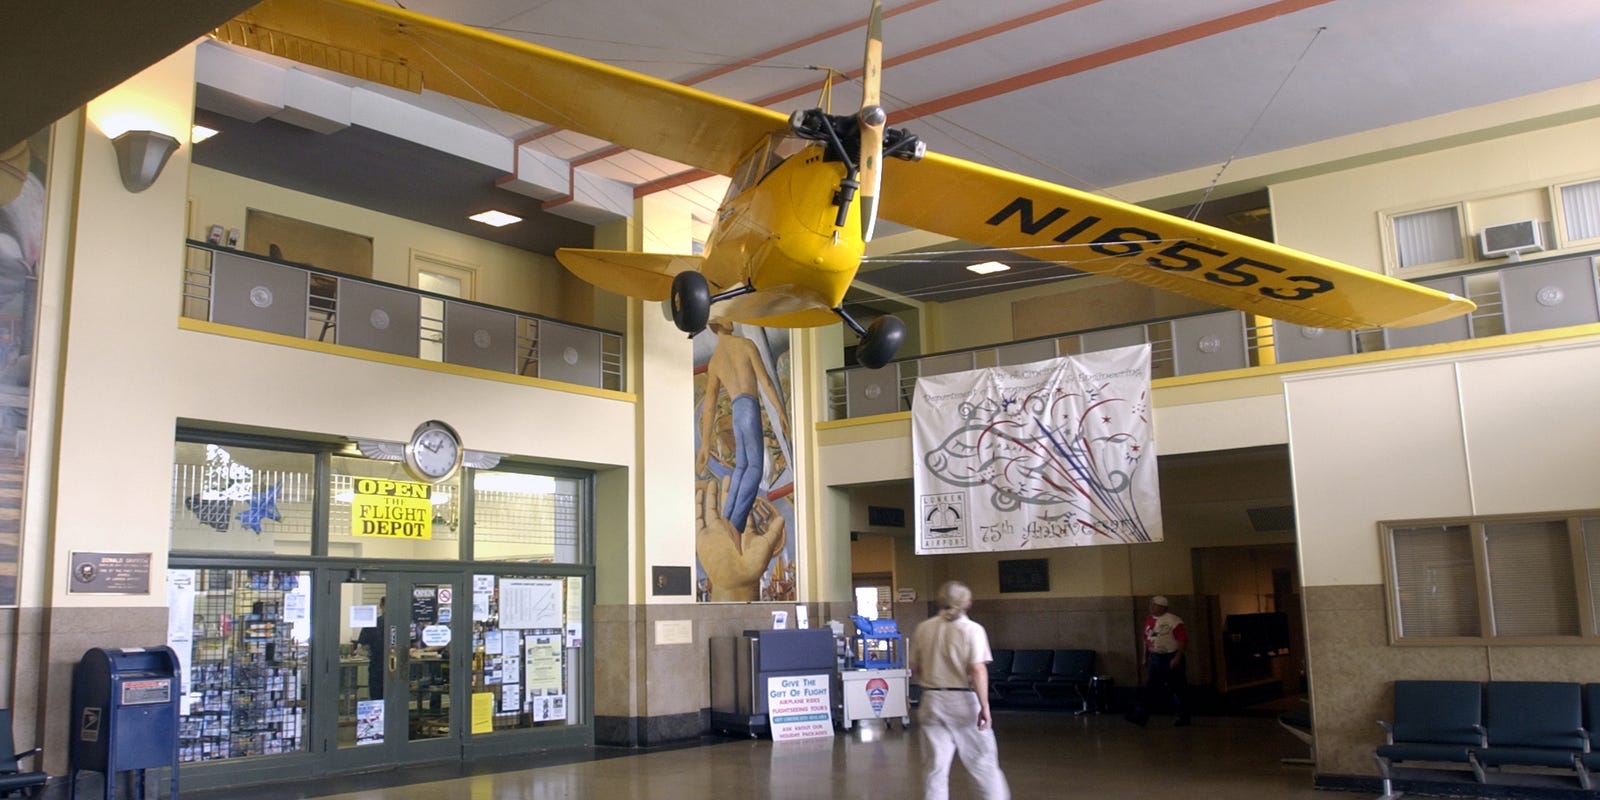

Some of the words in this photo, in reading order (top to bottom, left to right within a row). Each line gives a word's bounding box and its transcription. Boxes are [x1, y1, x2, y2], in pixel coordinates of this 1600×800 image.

[985, 197, 1335, 301] N16553
[358, 480, 428, 499] OPEN
[359, 504, 427, 522] FLIGHT
[362, 520, 425, 537] DEPOT
[979, 519, 1015, 543] 75th
[925, 538, 965, 547] AIRPORT
[781, 680, 800, 688] GIVE
[803, 679, 816, 687] THE
[770, 690, 787, 698] GIFT
[790, 689, 801, 697] OF
[804, 688, 827, 696] FLIGHT
